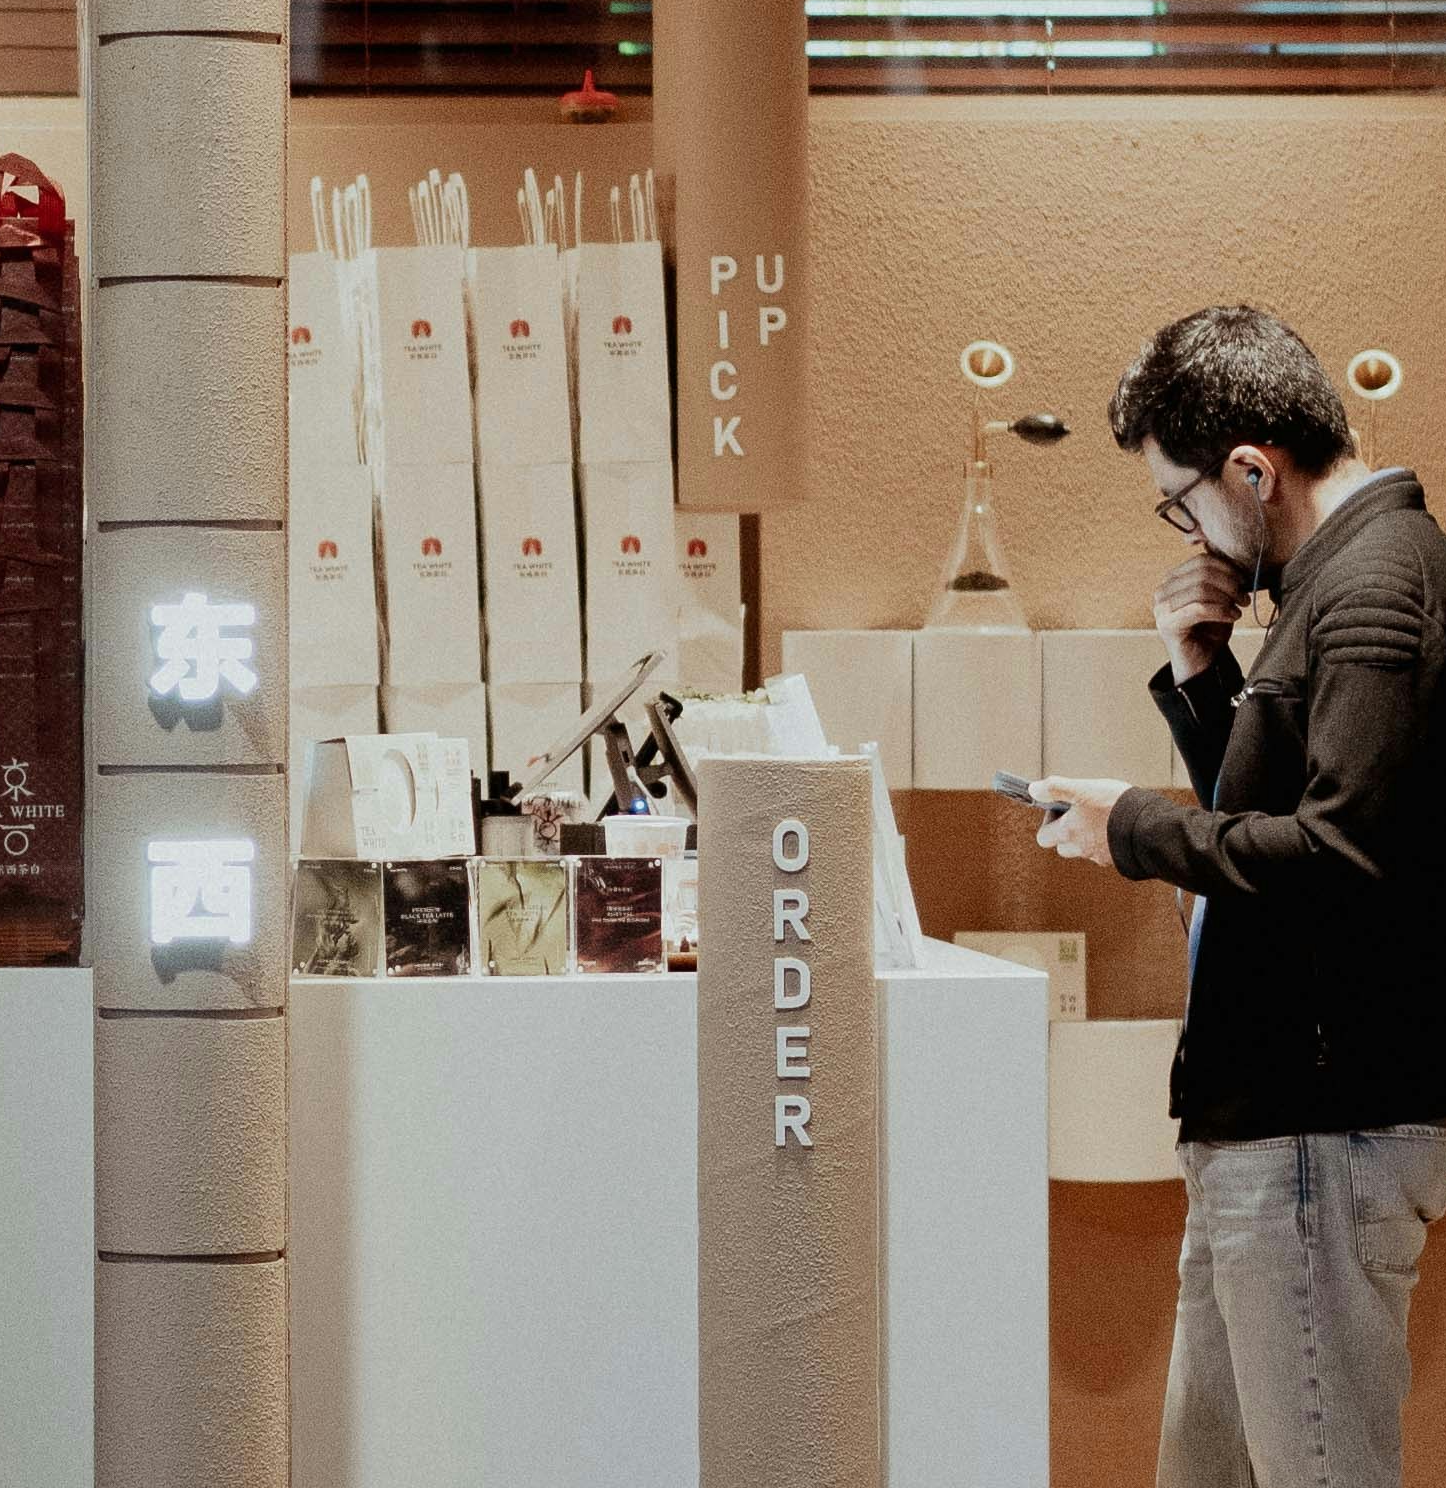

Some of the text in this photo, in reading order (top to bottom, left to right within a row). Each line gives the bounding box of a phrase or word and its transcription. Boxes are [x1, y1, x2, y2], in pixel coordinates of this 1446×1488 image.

[710, 255, 744, 457] PICK
[755, 255, 787, 346] UP
[10, 804, 65, 819] WHITE
[147, 593, 258, 945] 东西
[772, 819, 814, 1147] ORDER
